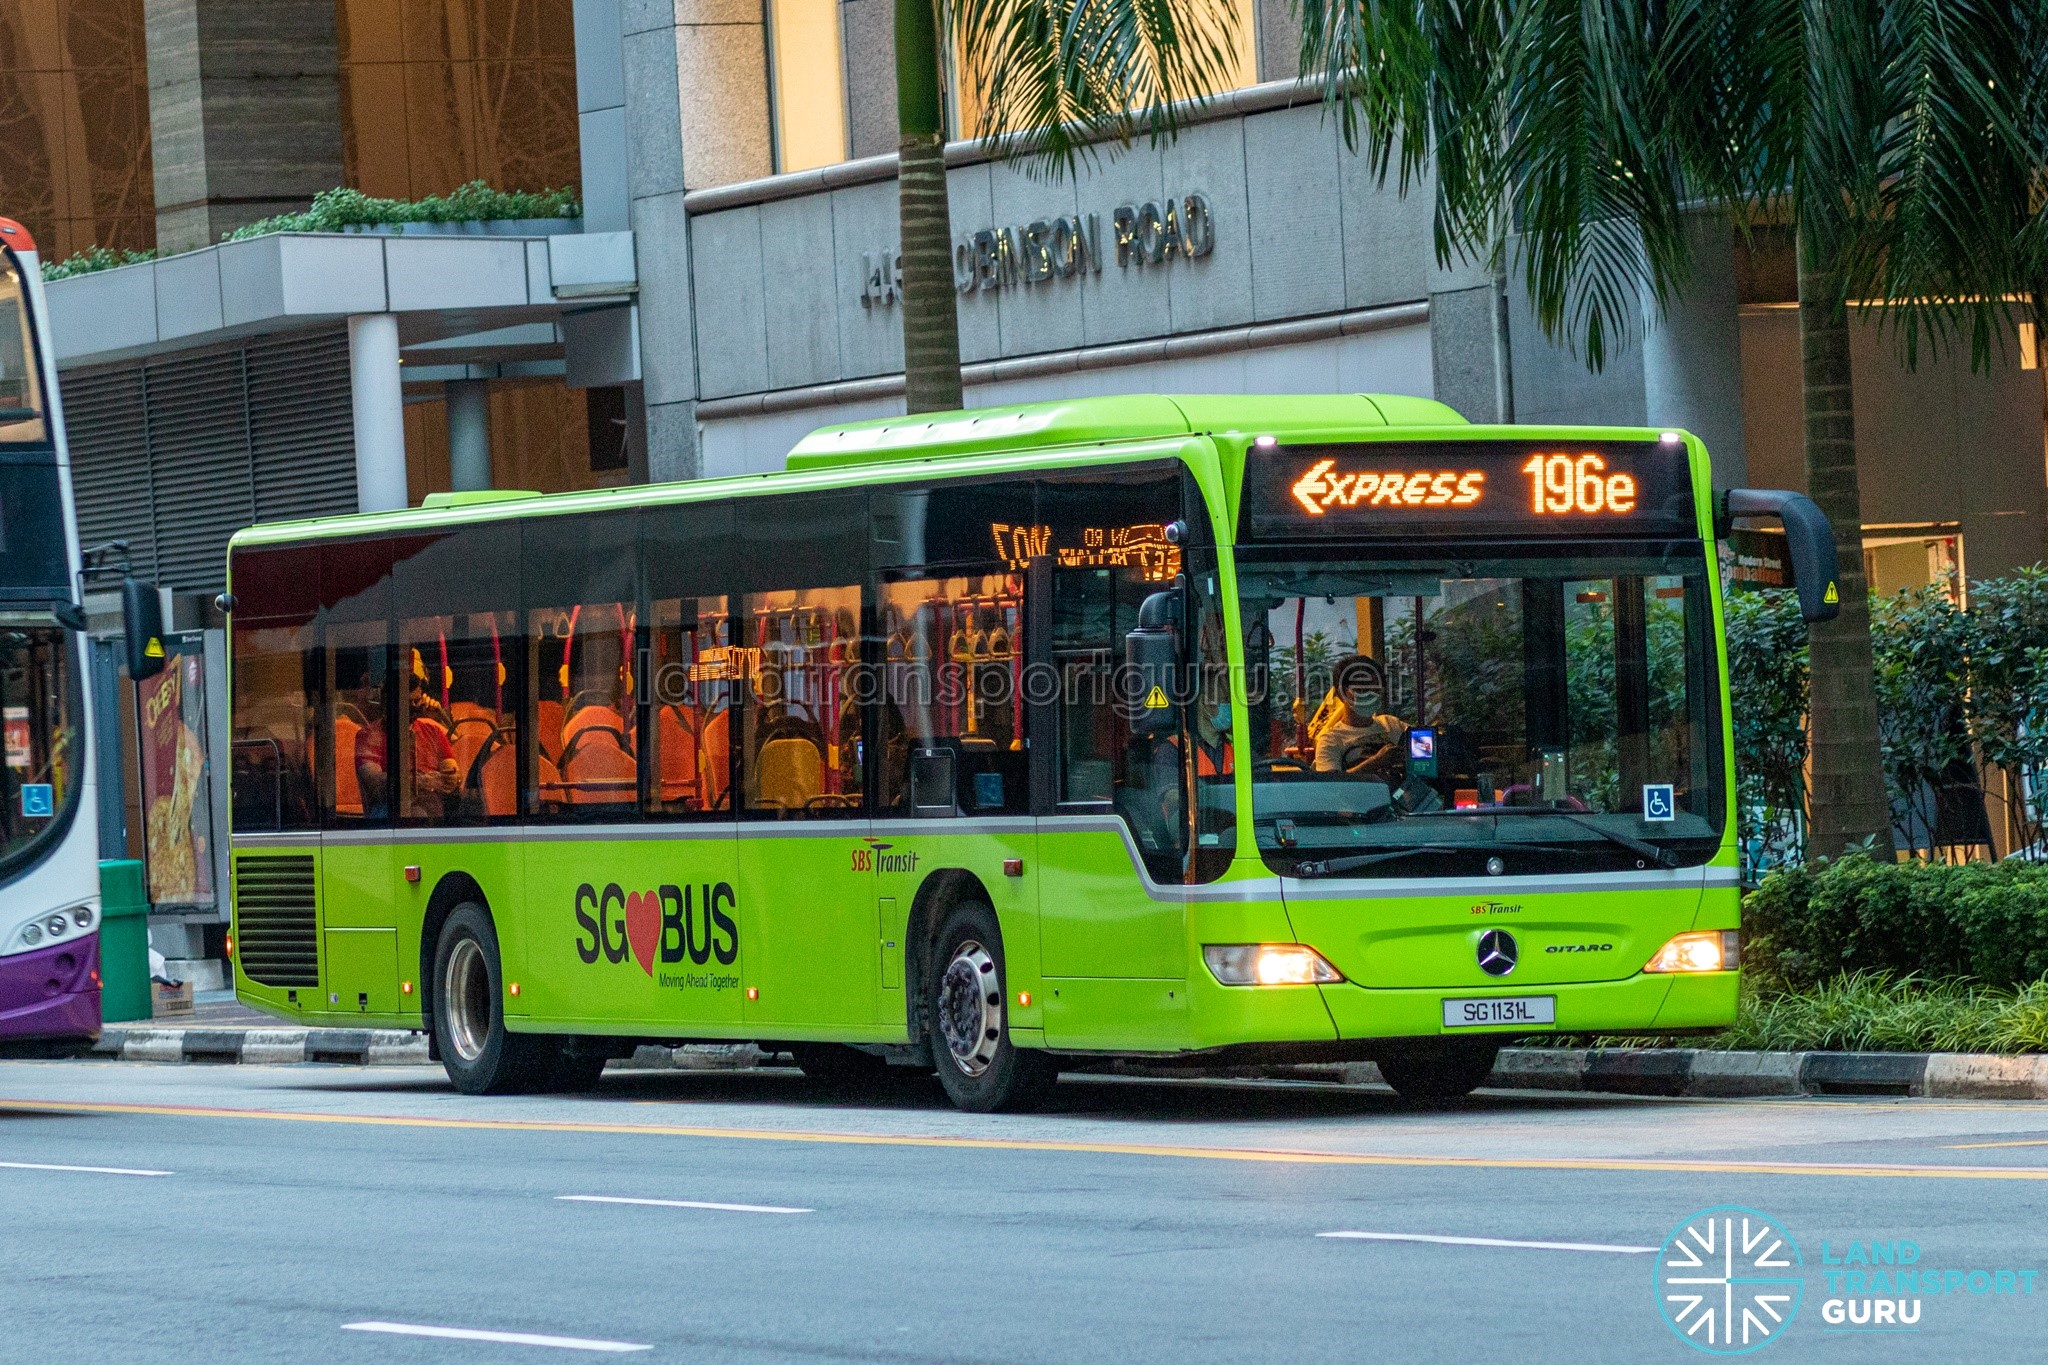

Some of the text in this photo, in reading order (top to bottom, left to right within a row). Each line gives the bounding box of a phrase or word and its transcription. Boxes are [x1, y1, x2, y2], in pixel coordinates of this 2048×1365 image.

[955, 213, 1102, 292] OBINSON
[1114, 193, 1215, 267] ROAD
[1292, 455, 1635, 514] EXPRESS 196e
[851, 843, 920, 878] SBS Transit
[1470, 902, 1524, 915] SBS Transit
[659, 973, 739, 991] Moving Ahead Together
